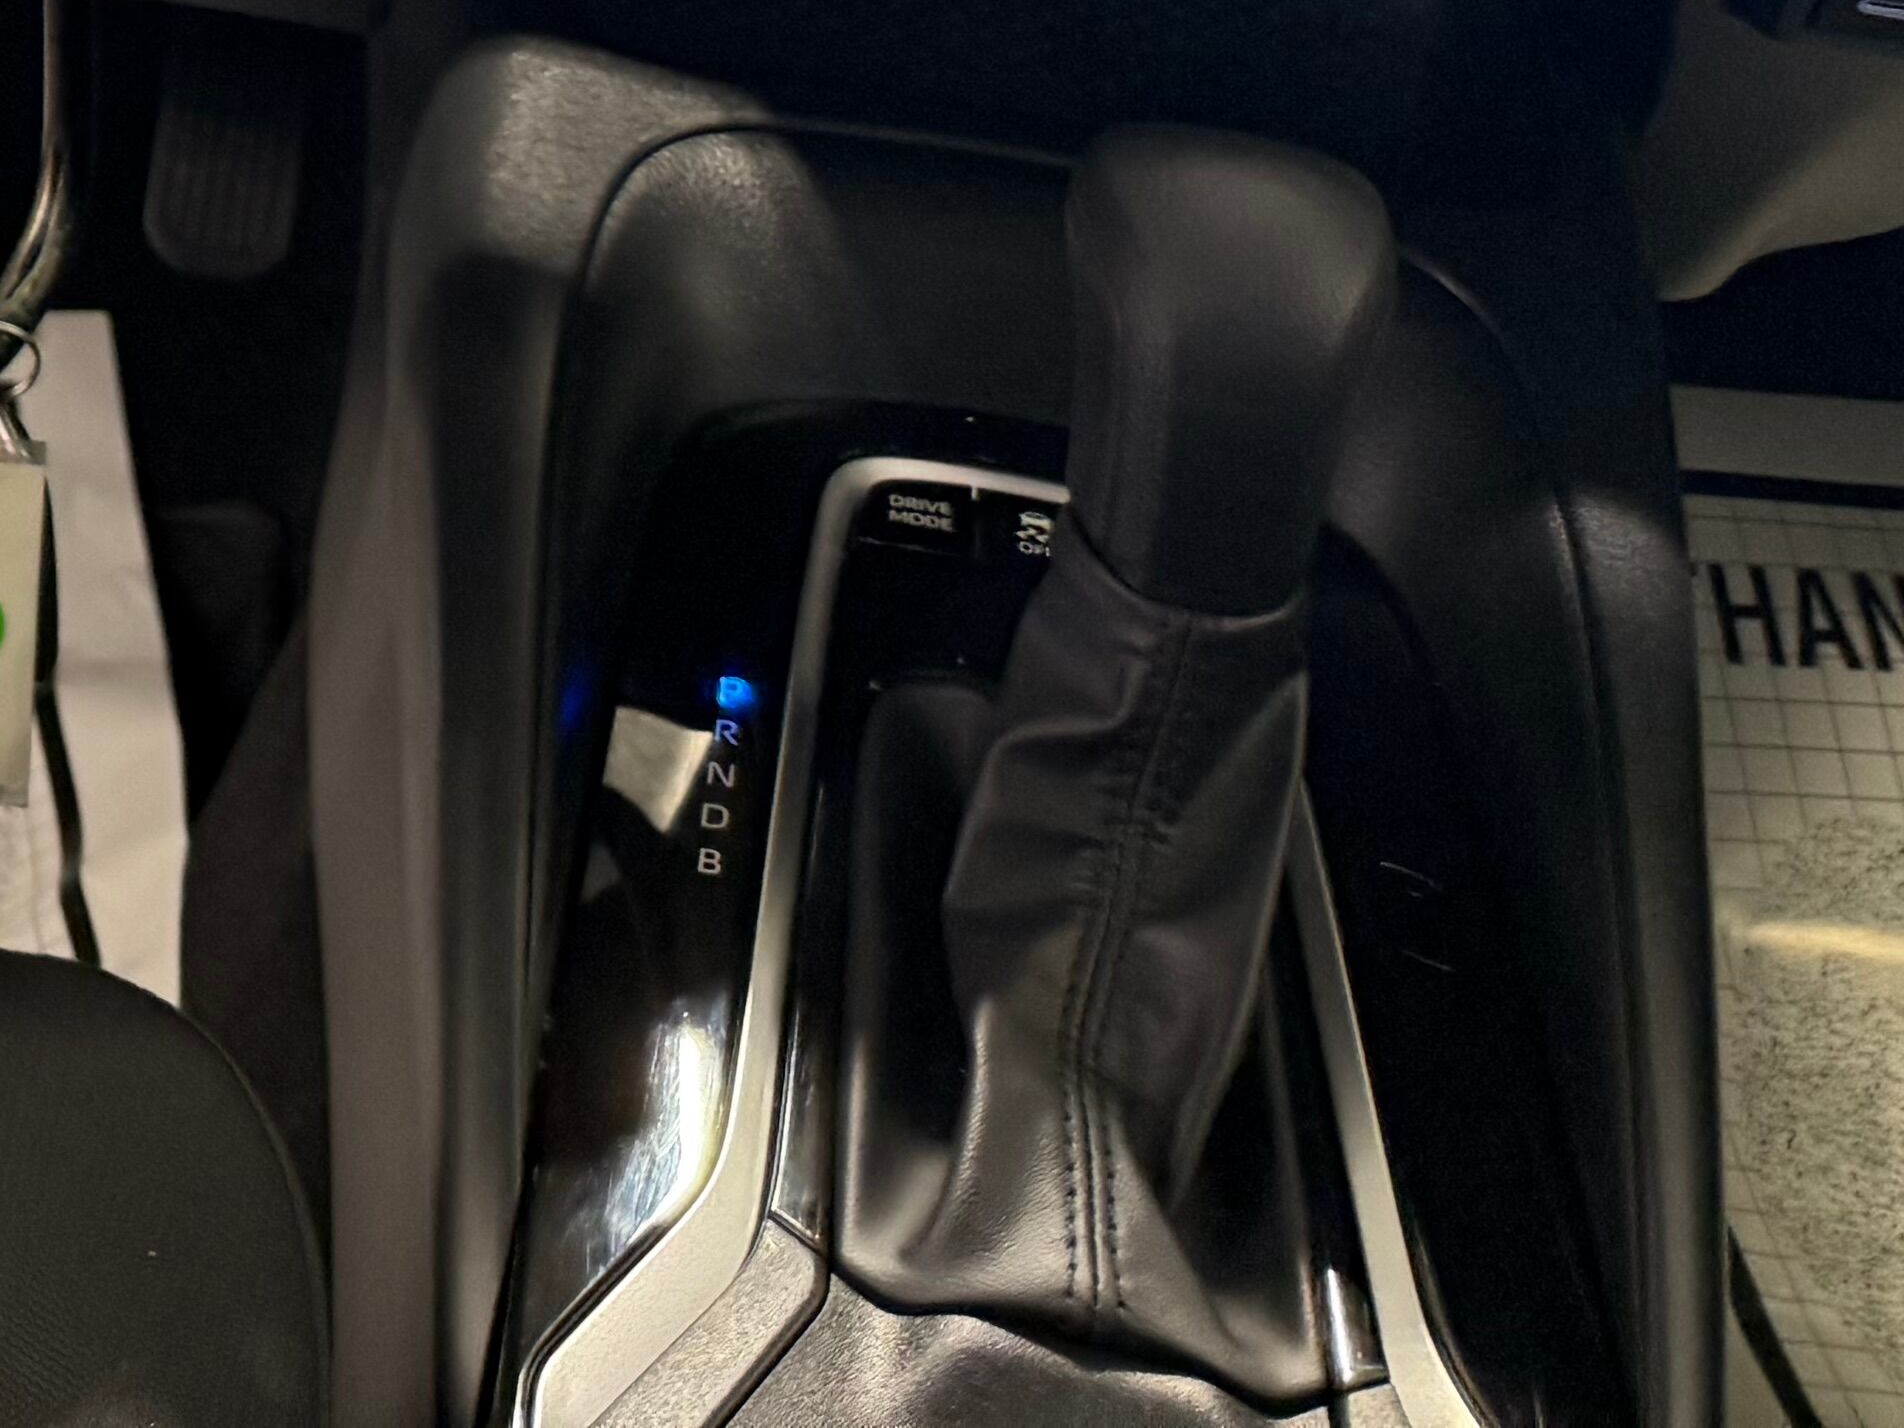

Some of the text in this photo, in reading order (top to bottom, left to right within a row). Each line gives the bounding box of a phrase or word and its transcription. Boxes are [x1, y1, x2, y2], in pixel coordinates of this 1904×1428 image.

[888, 494, 953, 516] DRIVE
[888, 510, 956, 533] MODE
[1689, 562, 1904, 672] HAN
[717, 676, 749, 708] P
[714, 719, 739, 746] R
[707, 761, 735, 788] N
[700, 803, 730, 829] D
[697, 847, 722, 875] B
